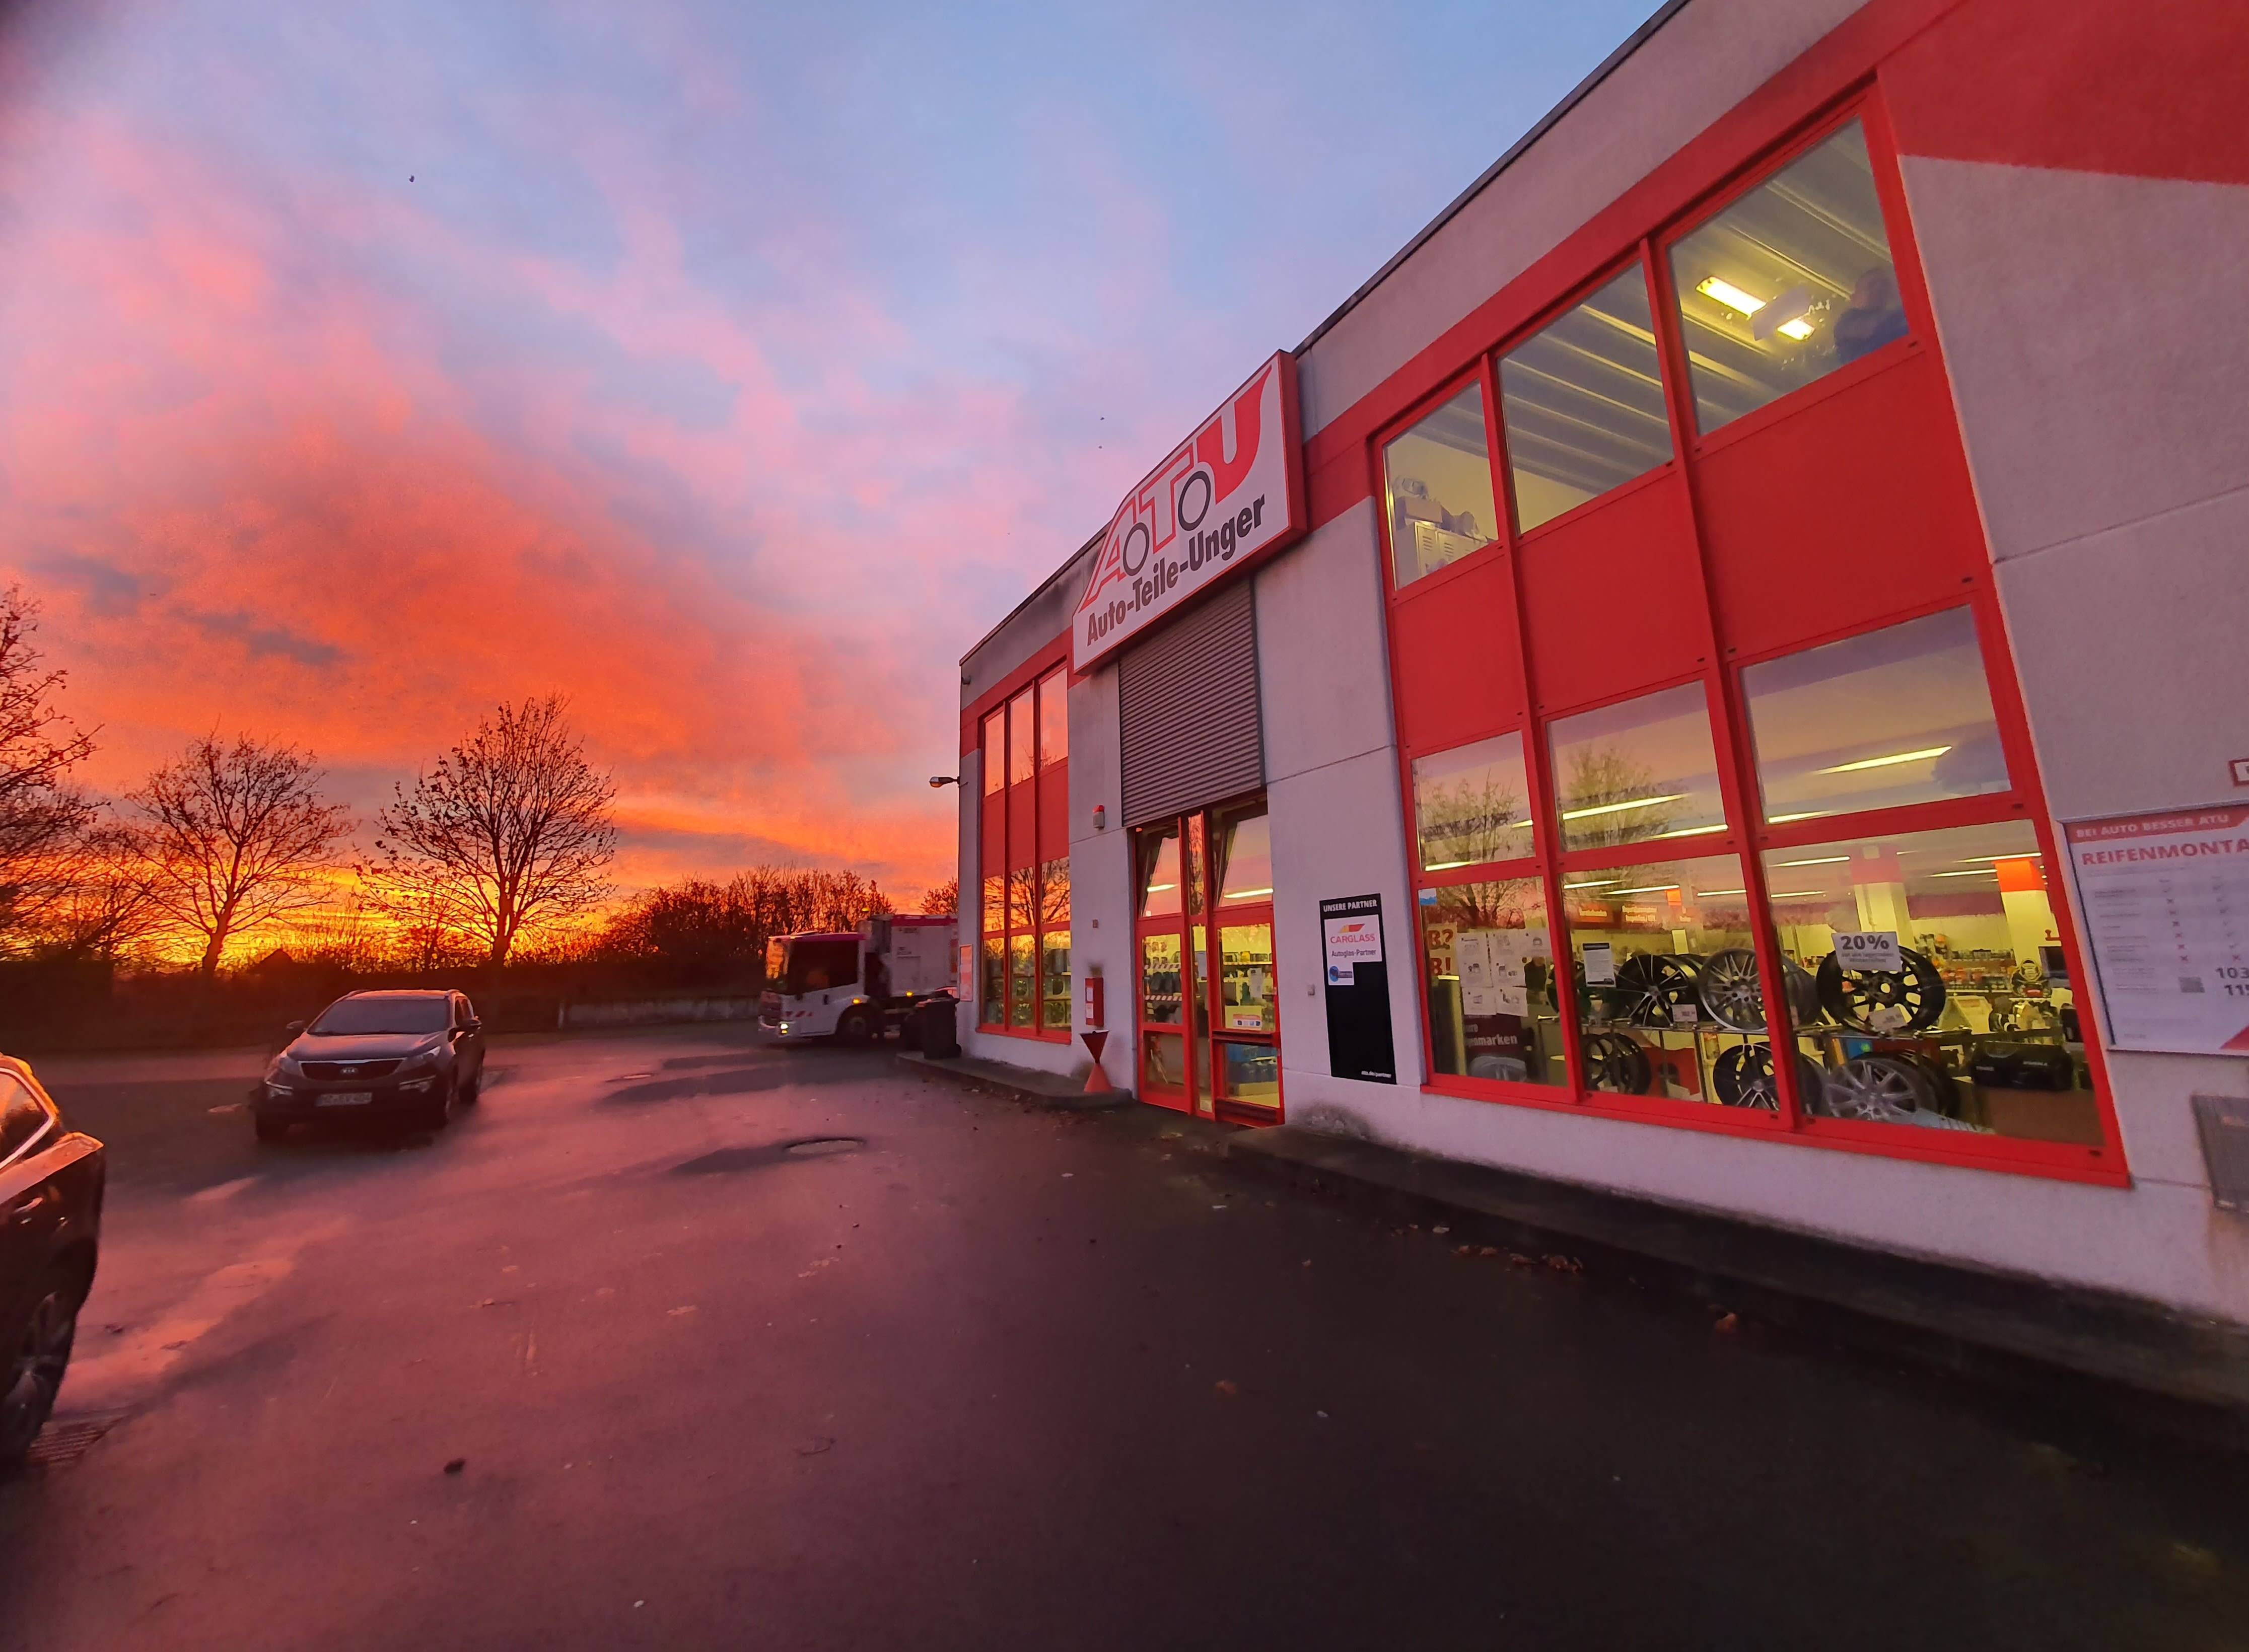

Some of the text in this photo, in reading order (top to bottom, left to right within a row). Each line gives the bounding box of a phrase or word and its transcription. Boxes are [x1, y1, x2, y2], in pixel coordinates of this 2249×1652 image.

[1087, 493, 1265, 647] Auto-Teile-Unger
[2077, 815, 2228, 837] BEI AUTO BESSER ATU
[1323, 899, 1377, 912] UNSERE PARTNER
[1330, 933, 1375, 944] CARGLASS
